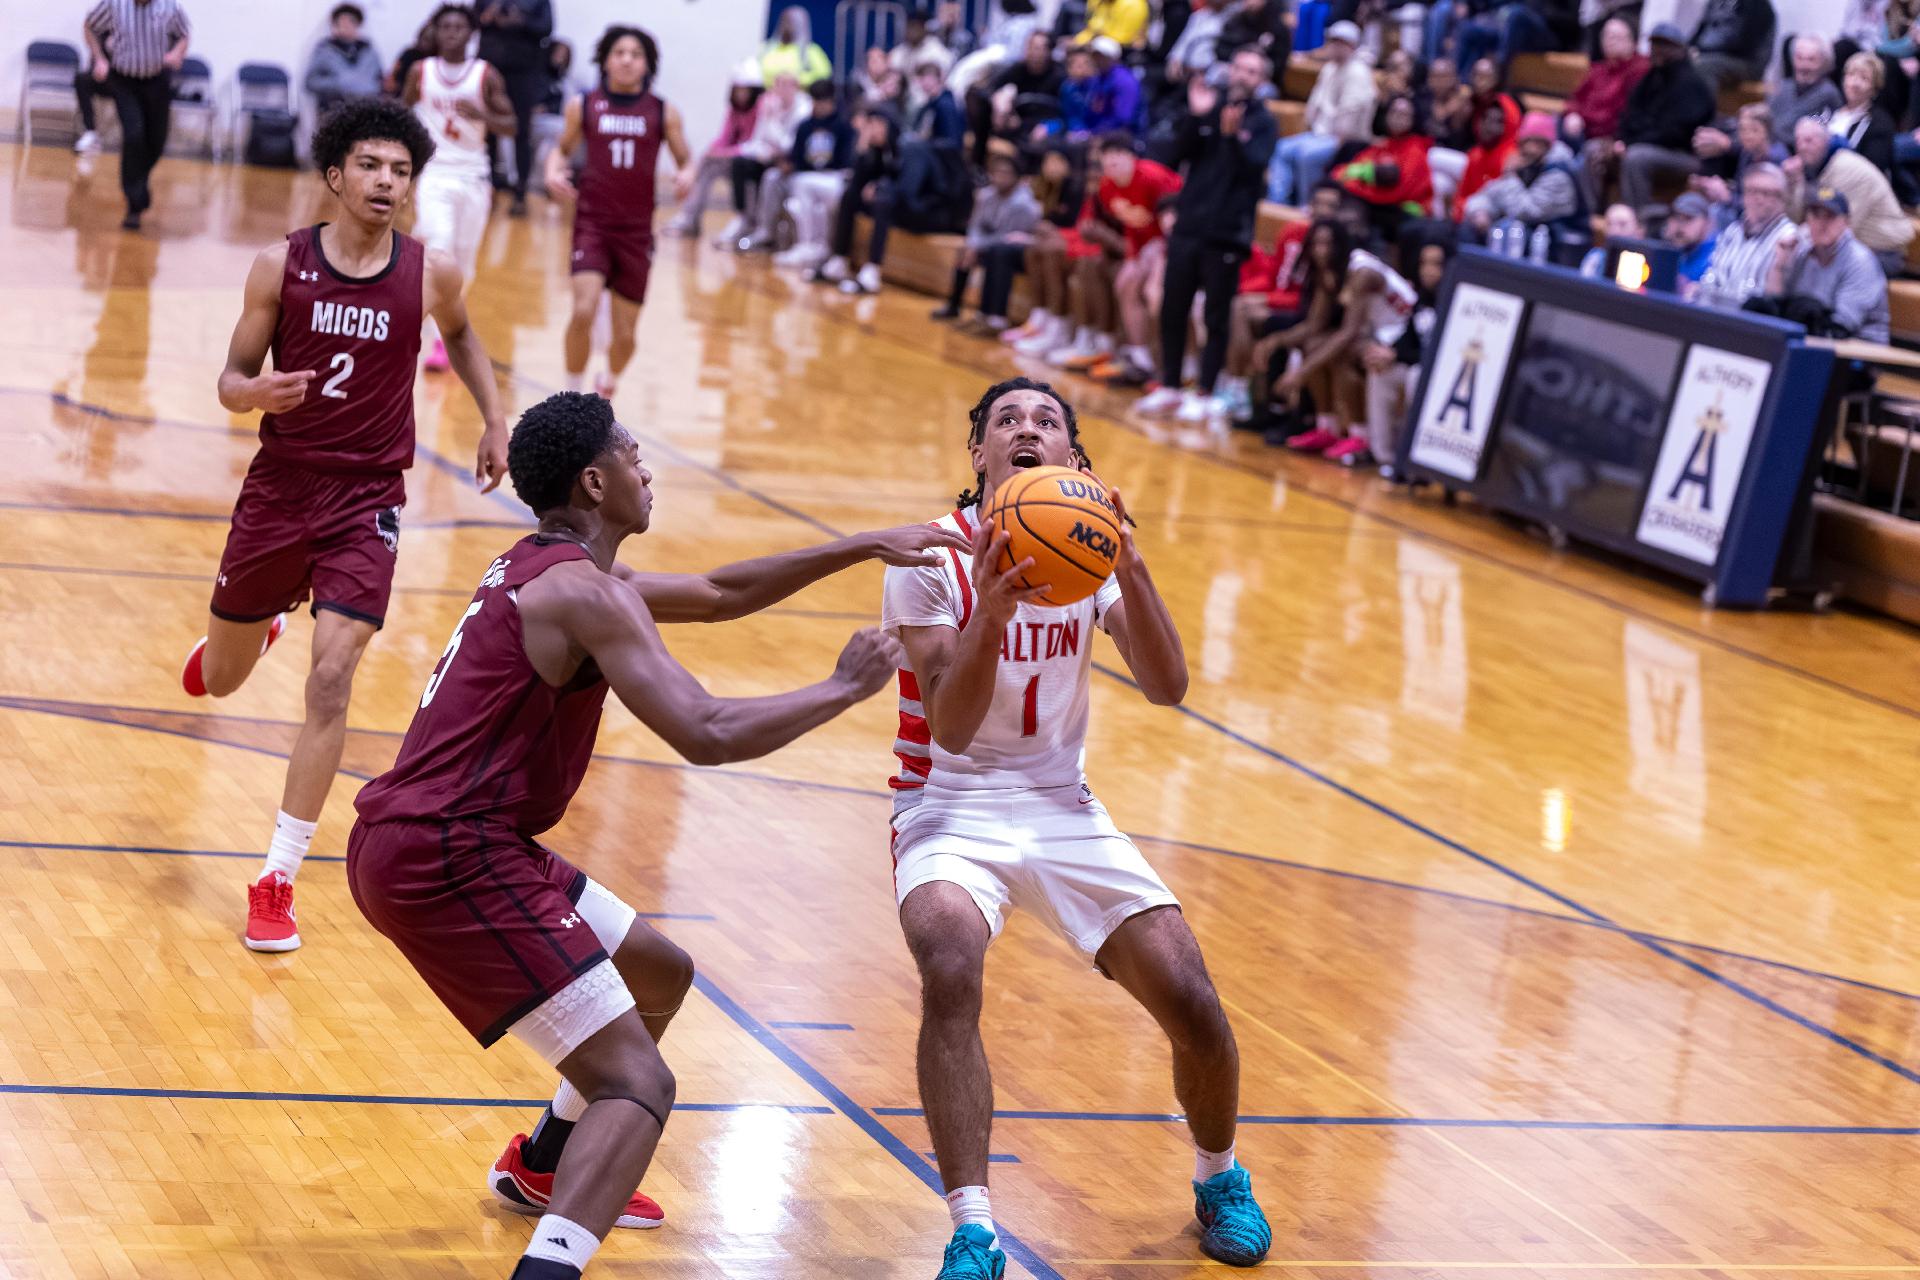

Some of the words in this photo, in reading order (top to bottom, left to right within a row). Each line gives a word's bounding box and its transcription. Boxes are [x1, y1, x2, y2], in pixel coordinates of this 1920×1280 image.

[598, 113, 647, 136] MICDS
[608, 137, 635, 169] 11
[310, 301, 391, 341] MICDS
[320, 352, 355, 400] 2
[1021, 672, 1042, 739] 1
